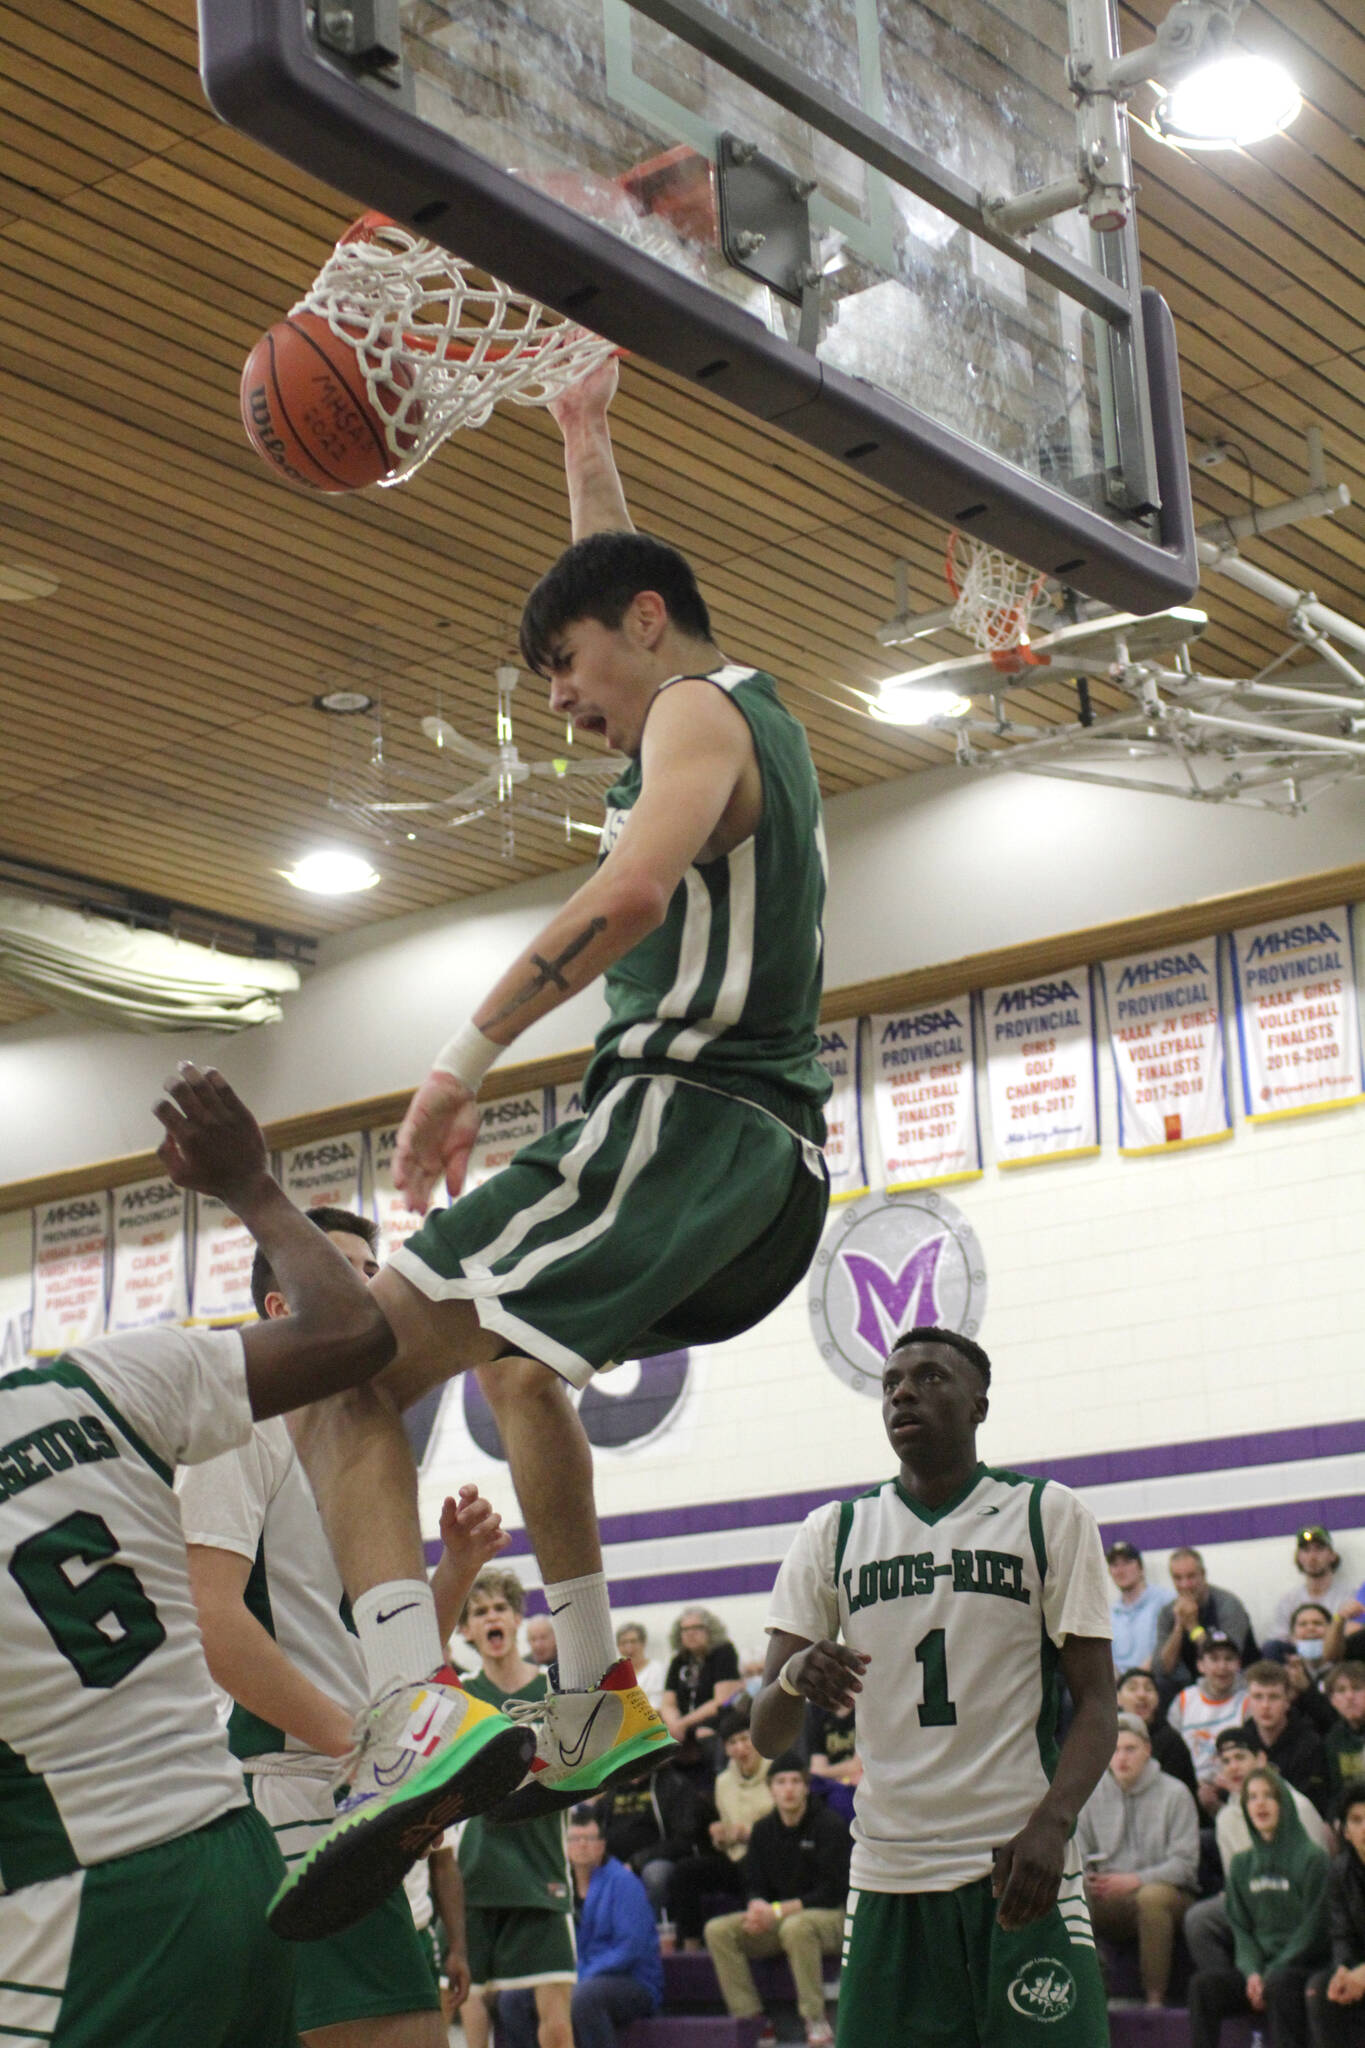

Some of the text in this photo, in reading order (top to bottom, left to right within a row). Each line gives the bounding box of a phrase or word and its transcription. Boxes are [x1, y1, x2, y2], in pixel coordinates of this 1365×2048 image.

[251, 384, 321, 489] Wilson
[1245, 921, 1342, 963] MHSAA
[1116, 952, 1209, 994] MHSAA
[1246, 951, 1343, 988] PROVINCIAL
[993, 980, 1080, 1016] MHSAA
[1117, 983, 1209, 1019] PROVINCIAL
[1303, 978, 1342, 1001] GIRLS
[880, 1009, 963, 1044] MHSAA
[995, 1008, 1081, 1041] PROVINCIAL
[1162, 1017, 1177, 1035] JV
[1182, 1007, 1217, 1030] GIRLS
[1258, 1001, 1339, 1030] VOLLEYBALL
[1021, 1037, 1056, 1056] GIRLS
[1128, 1034, 1204, 1062] VOLLEYBALL
[1267, 1023, 1334, 1049] FINALISTS
[882, 1036, 963, 1068] PROVINCIAL
[929, 1061, 962, 1080] GIRLS
[1025, 1058, 1053, 1076] GOLF
[1137, 1056, 1200, 1083] FINALISTS
[891, 1082, 959, 1107] VOLLEYBALL
[1006, 1075, 1077, 1101] CHAMPIONS
[482, 1099, 540, 1126] HSAA
[898, 1102, 955, 1124] FINALISTS
[289, 1142, 355, 1172] MHSAA
[289, 1166, 357, 1189] PROVINCIAL
[43, 1202, 102, 1227] MHSAA
[0, 1416, 120, 1504] GEURS
[843, 1549, 1030, 1616] LOUIS-RIEL
[8, 1510, 166, 1689] 6
[915, 1628, 957, 1727] 1
